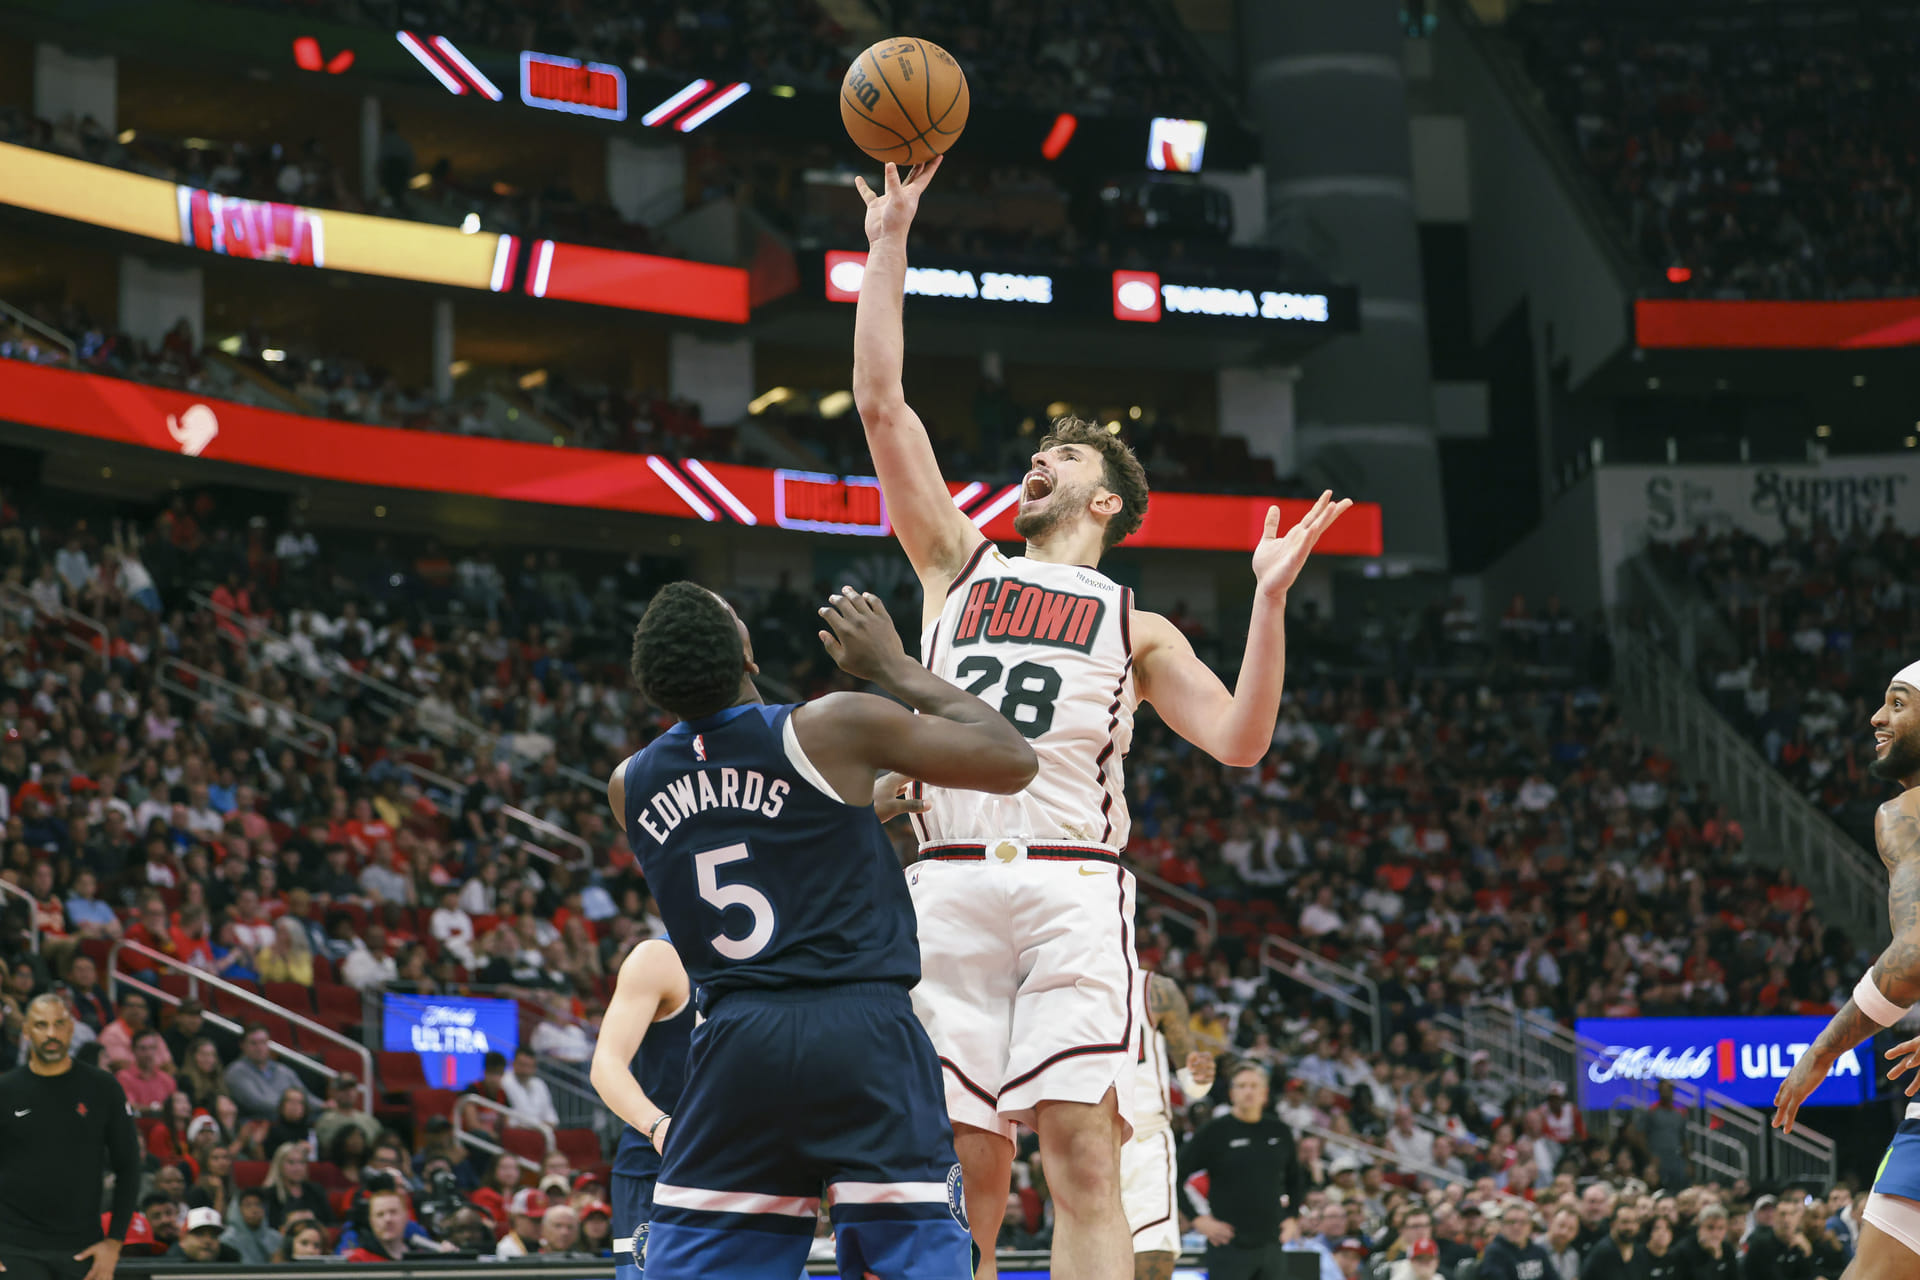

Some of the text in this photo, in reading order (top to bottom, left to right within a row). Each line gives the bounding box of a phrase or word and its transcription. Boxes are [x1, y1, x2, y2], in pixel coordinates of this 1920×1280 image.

[980, 272, 1053, 304] ZONE
[1260, 291, 1329, 322] ZONE
[956, 656, 1063, 739] 28
[637, 767, 790, 845] EDWARDS
[695, 842, 775, 960] 5
[1741, 1043, 1861, 1079] ULTA
